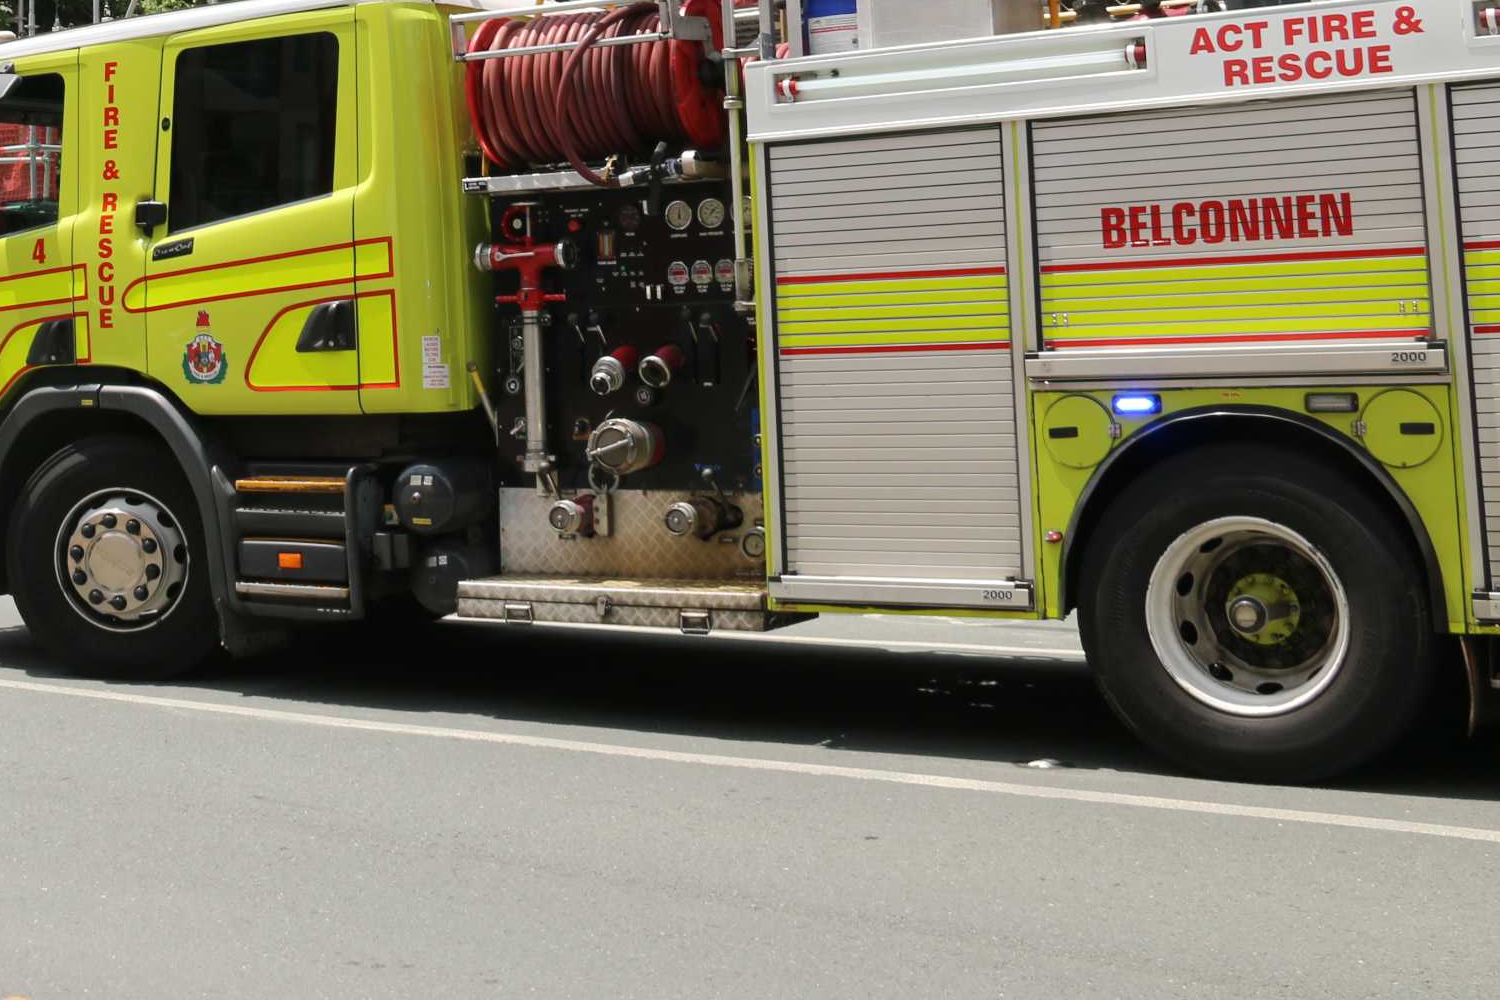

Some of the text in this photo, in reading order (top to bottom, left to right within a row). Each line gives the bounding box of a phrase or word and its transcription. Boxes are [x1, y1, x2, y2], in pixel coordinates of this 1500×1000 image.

[1189, 6, 1425, 55] ACT FIRE &
[1223, 45, 1393, 87] RESCUE
[98, 61, 120, 328] FIRE & RESCUE
[1100, 192, 1353, 249] BELCONNEN
[32, 238, 46, 264] 4
[1391, 351, 1427, 363] 2000
[982, 590, 1013, 600] 2000
